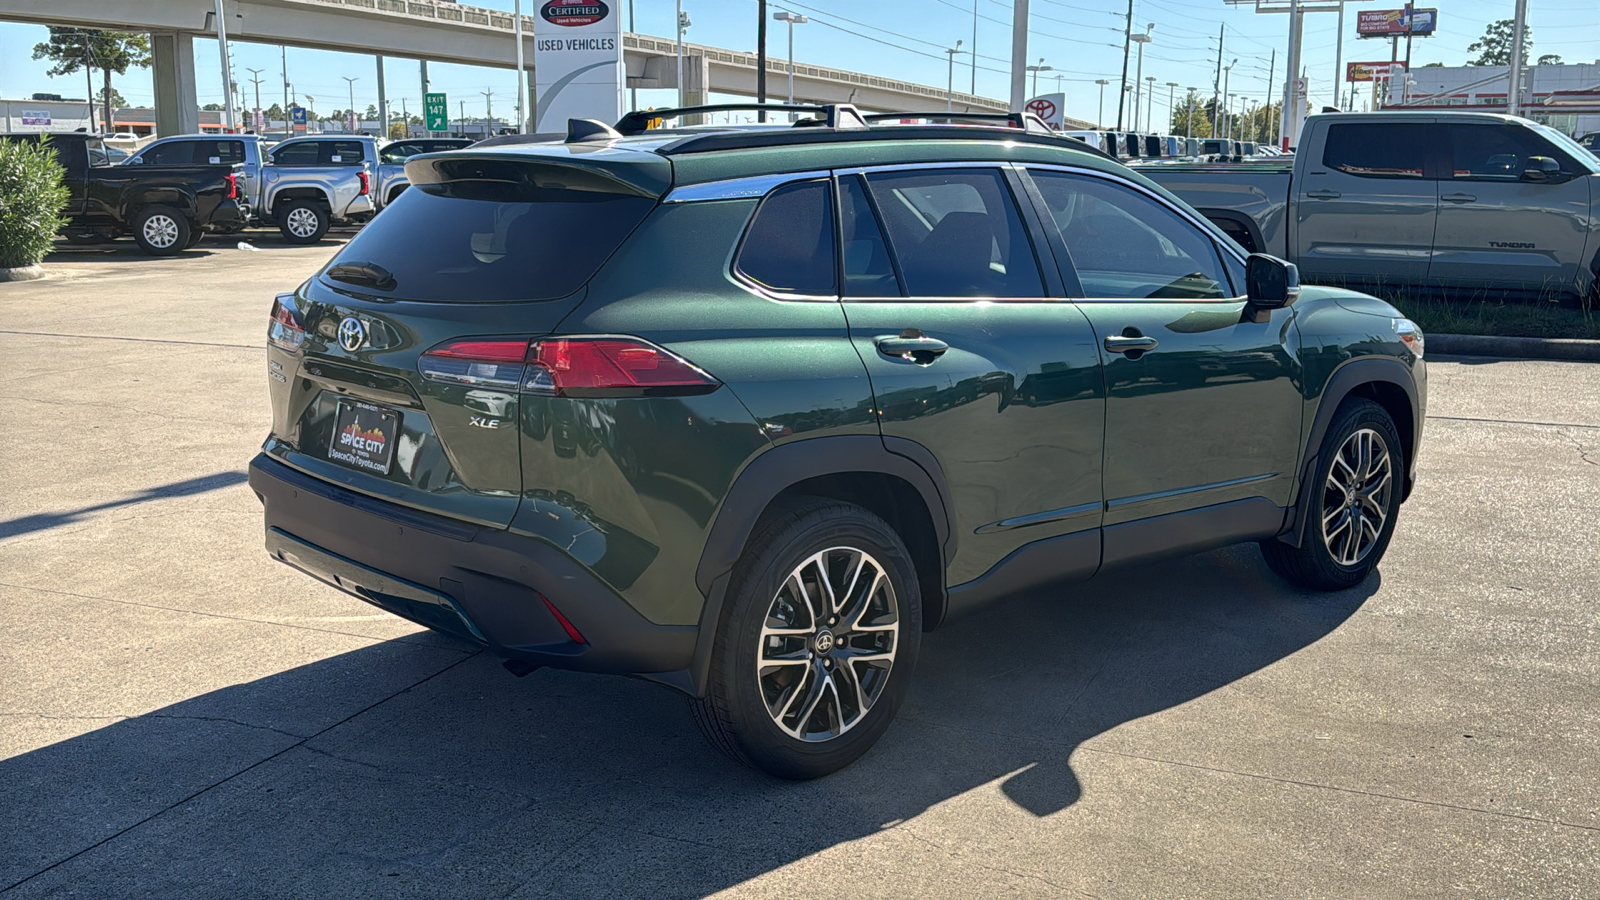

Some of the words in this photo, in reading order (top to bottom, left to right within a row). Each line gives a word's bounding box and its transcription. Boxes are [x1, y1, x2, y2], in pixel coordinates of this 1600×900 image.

[548, 6, 600, 16] CERTIFIED
[537, 39, 564, 52] USED
[566, 38, 615, 51] VEHICLES
[429, 105, 444, 115] 147
[468, 416, 500, 429] XLE
[340, 432, 366, 449] SPACE
[365, 439, 385, 454] CITY
[331, 449, 387, 472] SpaceCityToyota.com
